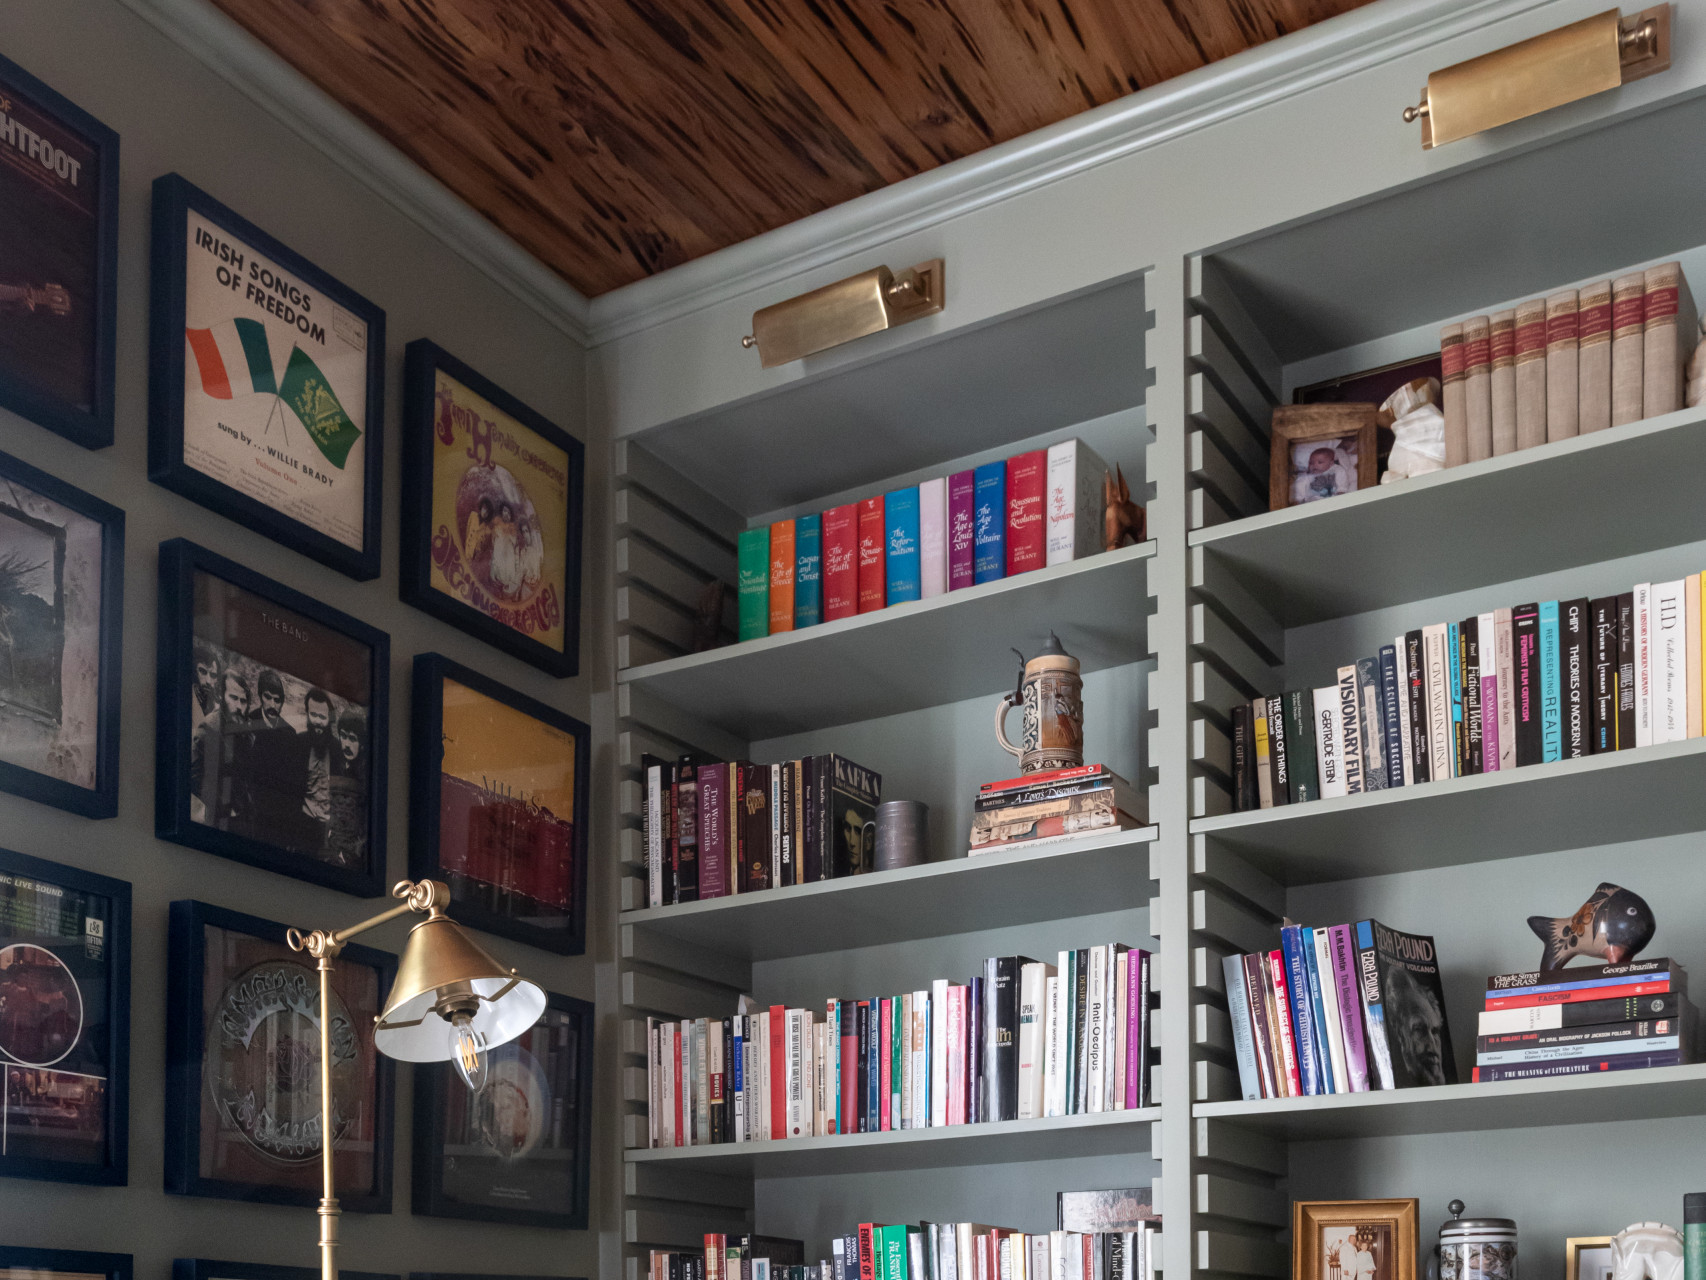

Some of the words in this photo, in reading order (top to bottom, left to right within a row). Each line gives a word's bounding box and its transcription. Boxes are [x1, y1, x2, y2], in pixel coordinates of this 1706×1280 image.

[195, 227, 244, 271] IRISH
[249, 262, 311, 312] SONGS
[216, 266, 241, 291] OF
[246, 282, 326, 345] FREEDOM
[218, 422, 239, 440] sung
[241, 431, 252, 446] by
[267, 446, 298, 471] WILLIE
[302, 463, 334, 487] BRADY
[1010, 496, 1040, 510] Rousseau
[1010, 513, 1042, 530] Revolution
[976, 534, 1001, 546] Voltaire
[1014, 553, 1037, 562] DURANT
[261, 611, 281, 632] THE
[282, 623, 310, 643] BAND
[1569, 606, 1579, 632] CHIPP
[1597, 624, 1610, 650] FUTURE
[1520, 635, 1528, 667] FEMINIST
[1545, 629, 1554, 696] REPRESENTING
[1386, 666, 1394, 681] THE
[1432, 662, 1441, 692] CIVIL
[1501, 667, 1509, 690] Journey
[1520, 669, 1529, 685] FILM
[1569, 644, 1580, 689] THEORIES
[1597, 663, 1610, 693] LITERARY
[1468, 666, 1480, 708] Fictional
[1570, 690, 1579, 702] OF
[1273, 697, 1281, 713] THE
[1340, 675, 1359, 756] VISIONARY
[1387, 686, 1396, 722] SCIENCE
[1433, 692, 1443, 717] WAR
[1521, 686, 1530, 722] CRITICISM
[1598, 695, 1611, 721] THEORY
[1235, 726, 1243, 742] THE
[1275, 714, 1283, 740] ORDER
[1322, 710, 1334, 758] GERTRUDE
[1389, 728, 1398, 737] OF
[1469, 710, 1481, 743] Worlds
[1570, 705, 1580, 747] MODERN
[1277, 741, 1284, 753] OF
[1435, 733, 1445, 769] CHINA
[1278, 755, 1286, 784] THINGS
[1325, 760, 1335, 784] STEIN
[1391, 743, 1401, 780] SUCCESS
[1346, 759, 1361, 795] FILM
[710, 788, 718, 806] THE
[711, 808, 719, 845] WORLD'S
[14, 877, 34, 891] LIVE
[35, 883, 64, 898] SOUND
[1336, 943, 1348, 972] Bakhtin
[1394, 931, 1433, 962] POUND
[1291, 956, 1300, 974] THE
[1360, 951, 1375, 972] EZRA
[1406, 963, 1435, 974] VOLCANO
[1494, 974, 1518, 982] Claude
[1518, 972, 1540, 980] Simon
[1603, 966, 1629, 974] George
[1630, 962, 1658, 971] Braziller
[1293, 975, 1302, 997] STORY
[1340, 974, 1349, 986] The
[1362, 973, 1380, 1001] POUND
[1511, 979, 1538, 987] GRASS
[1249, 975, 1261, 1016] BELOVED
[1295, 998, 1303, 1010] OF
[1538, 993, 1571, 1002] FASCISM
[1090, 1002, 1102, 1071] Anti-Oedipus
[1296, 1011, 1312, 1069] CHRISTIANITY
[860, 1229, 870, 1263] ENEMIES
[862, 1265, 870, 1276] OF
